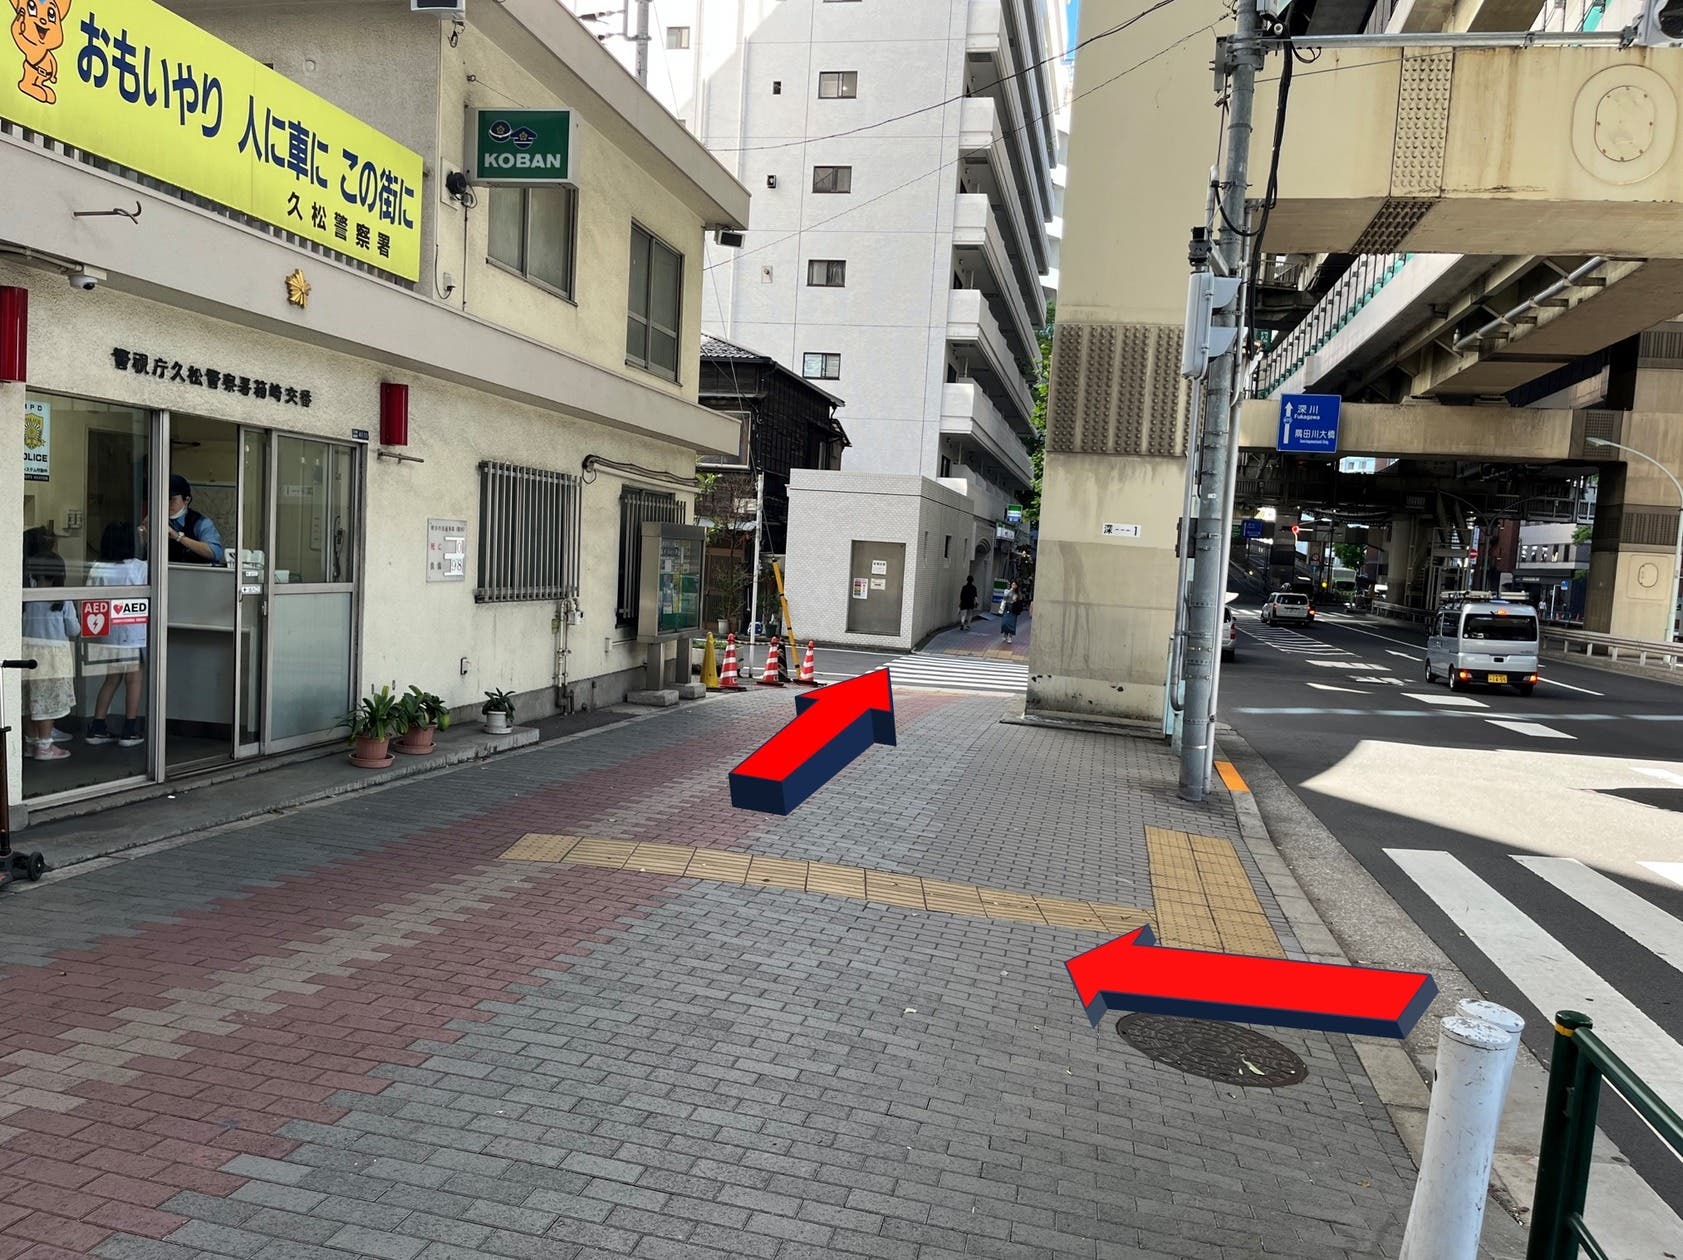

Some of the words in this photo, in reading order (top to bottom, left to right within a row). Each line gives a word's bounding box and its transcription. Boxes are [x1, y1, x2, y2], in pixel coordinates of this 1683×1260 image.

[77, 12, 223, 138] おもいやり
[238, 95, 329, 189] 人に車に
[340, 148, 414, 229] この街に
[484, 153, 561, 168] KOBAN
[287, 191, 391, 258] 久松警察署
[1297, 404, 1319, 414] 深川
[1295, 429, 1335, 439] 隅田川大橋
[85, 603, 108, 613] AED
[123, 603, 146, 612] AED
